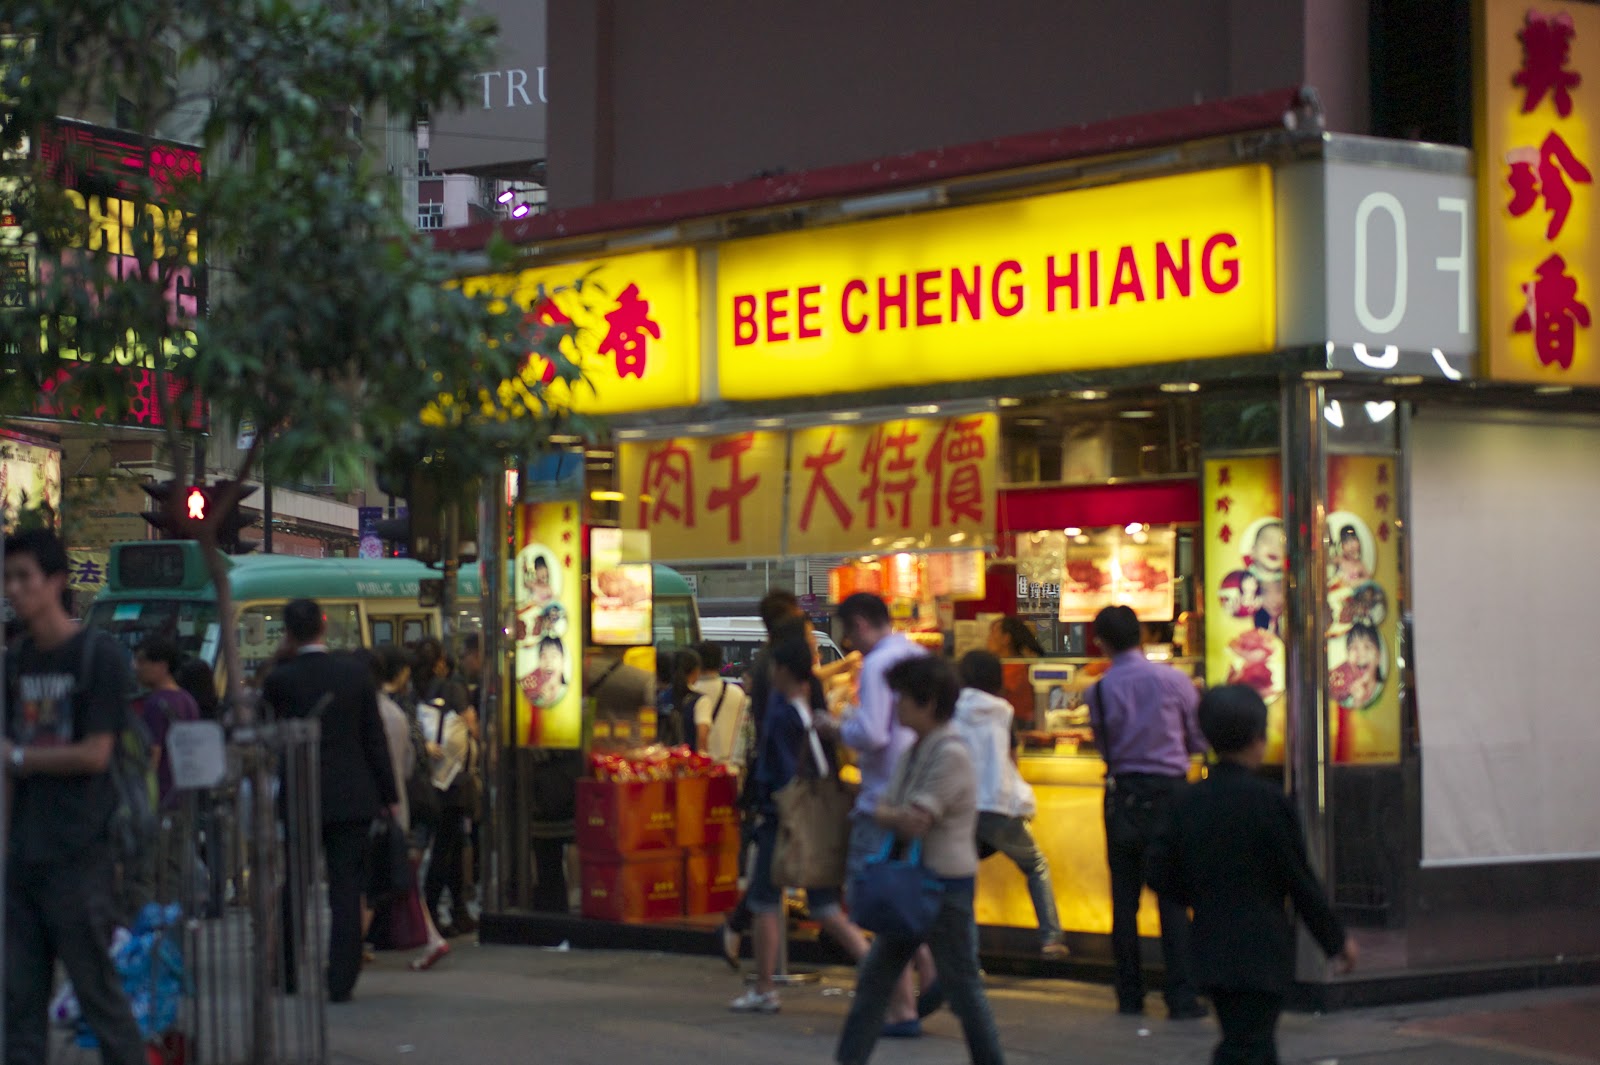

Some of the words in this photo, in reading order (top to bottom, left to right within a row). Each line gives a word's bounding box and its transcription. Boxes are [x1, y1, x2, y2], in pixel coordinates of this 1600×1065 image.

[733, 284, 822, 347] BEE
[840, 259, 1025, 335] CHENG
[1046, 231, 1240, 313] HIANG
[356, 581, 394, 595] PUBLIC
[399, 582, 421, 595] LIG
